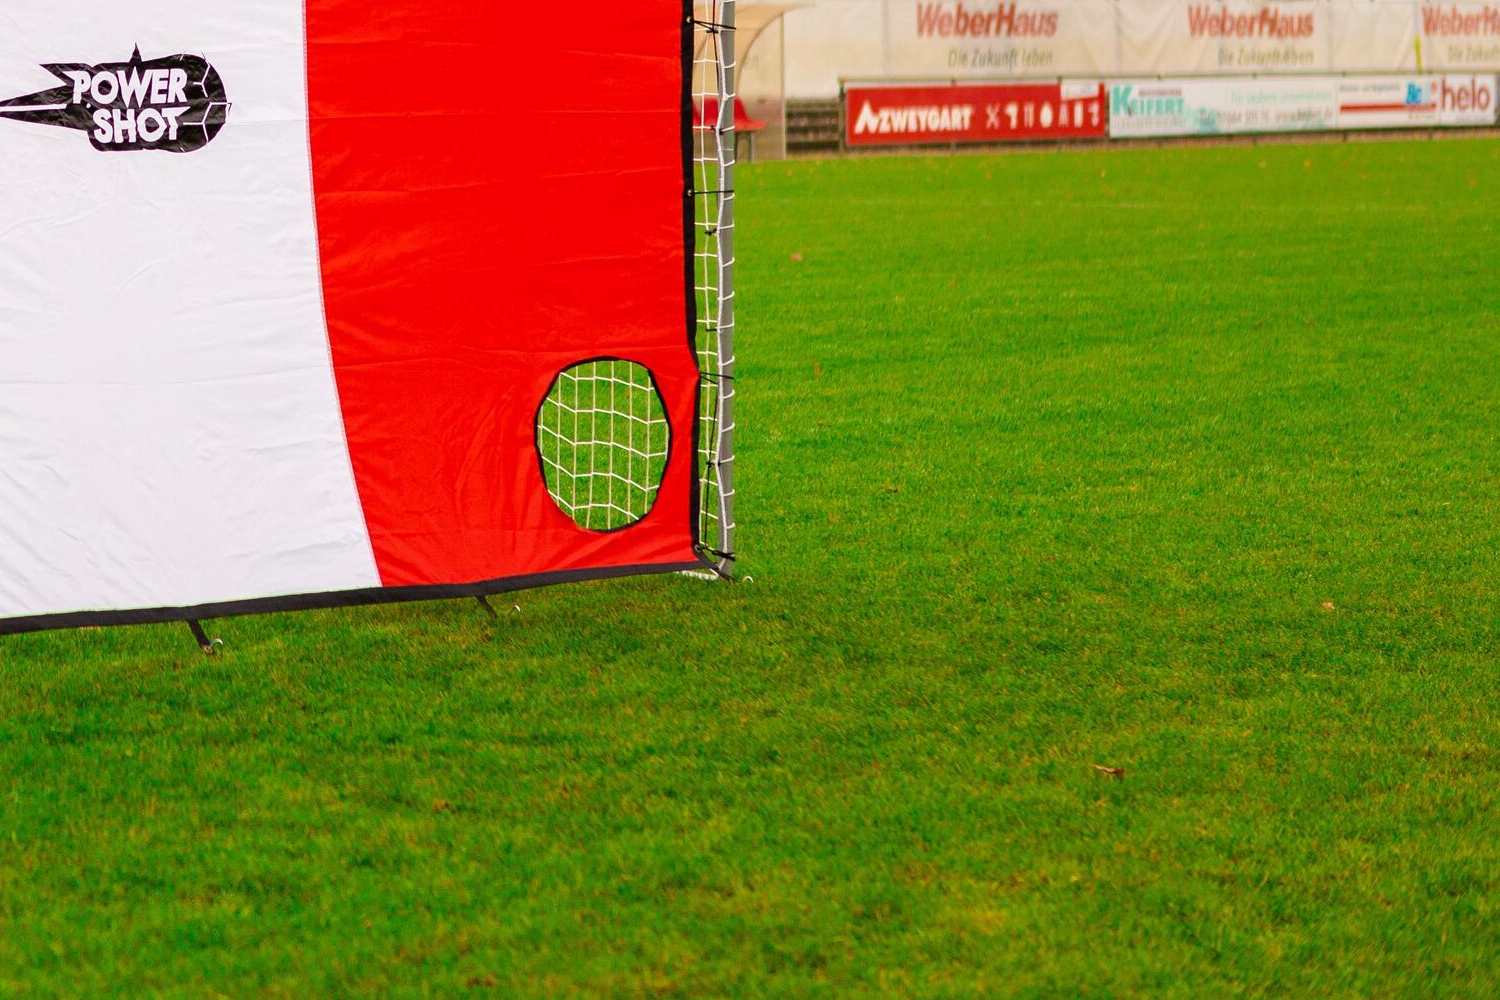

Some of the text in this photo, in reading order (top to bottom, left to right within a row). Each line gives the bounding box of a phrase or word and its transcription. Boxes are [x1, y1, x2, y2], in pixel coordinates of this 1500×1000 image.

[916, 1, 1059, 38] WeberHaus
[1187, 4, 1314, 38] WeberHaus
[948, 49, 1053, 72] Die Zukunft leben
[64, 66, 188, 109] POWER
[1441, 76, 1490, 112] helo
[92, 106, 190, 144] SHOT
